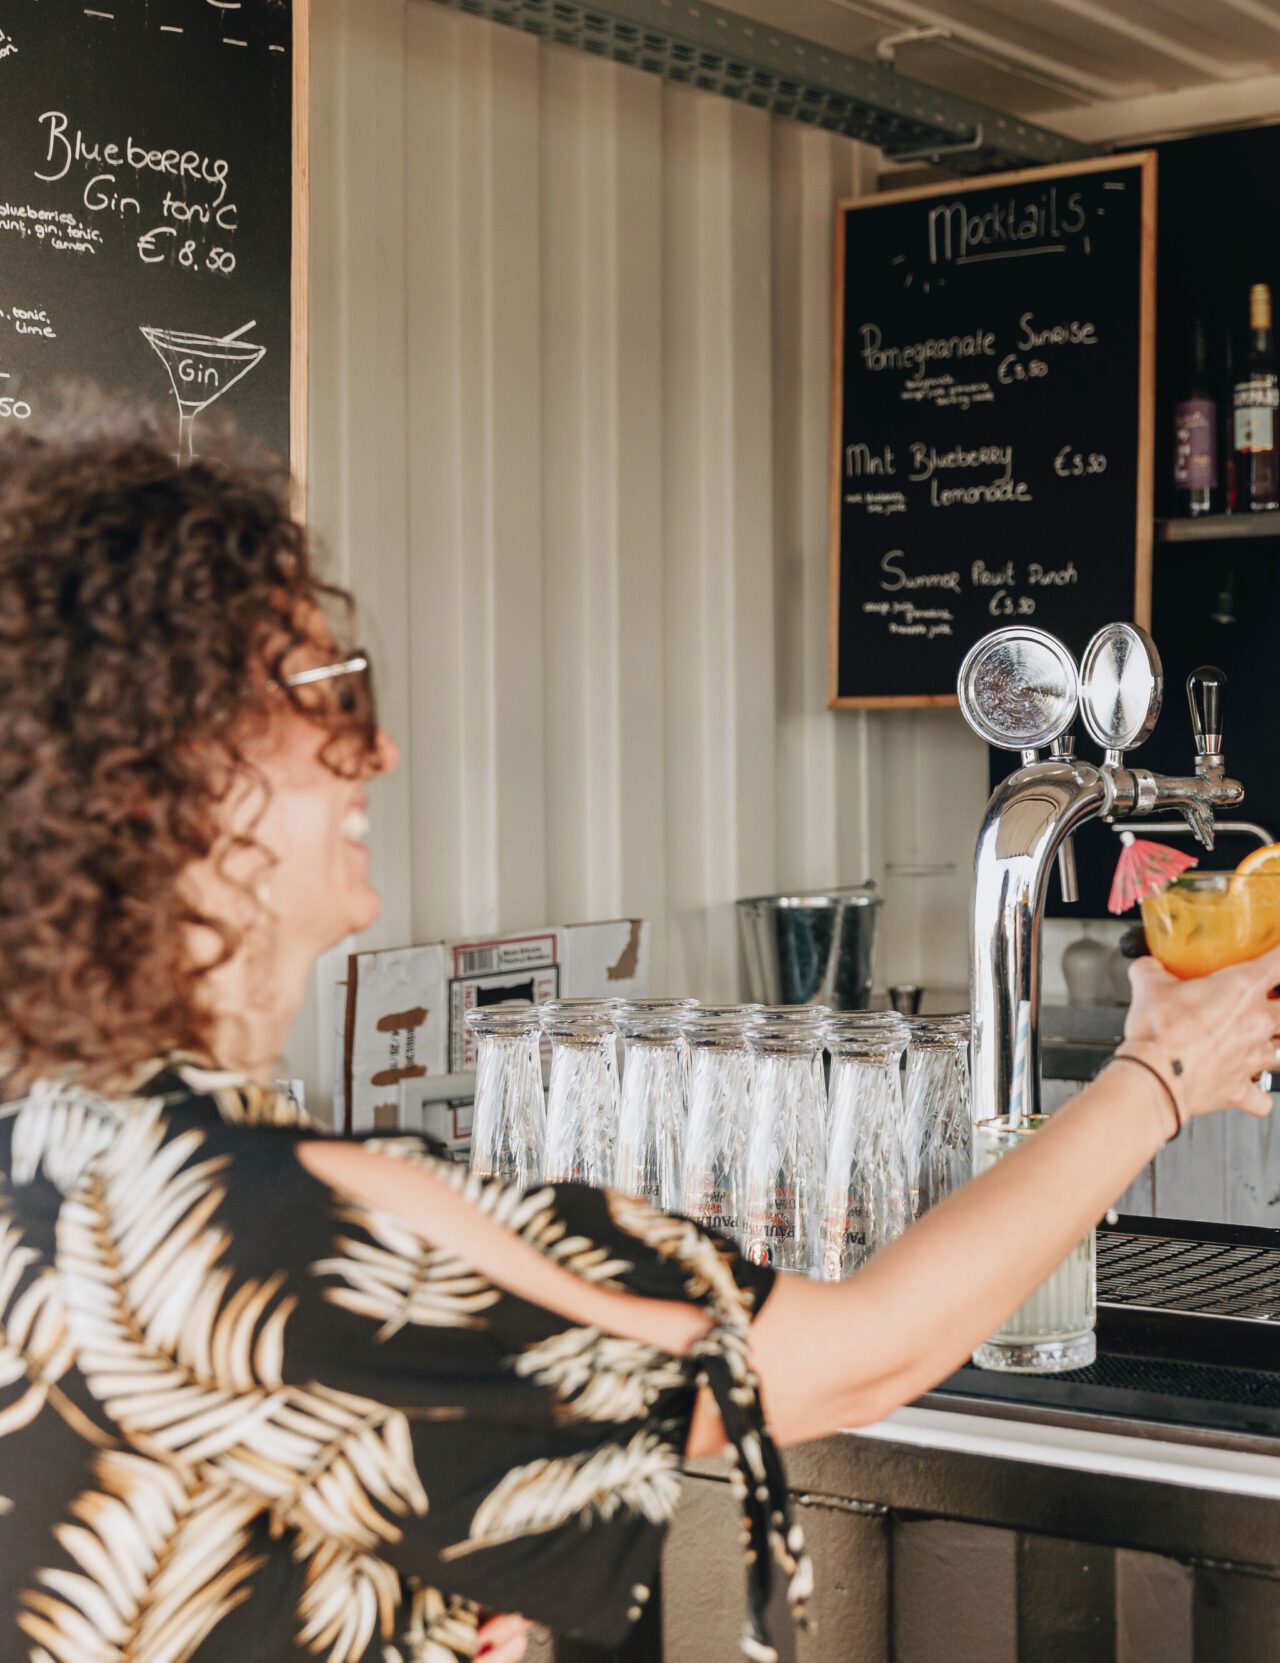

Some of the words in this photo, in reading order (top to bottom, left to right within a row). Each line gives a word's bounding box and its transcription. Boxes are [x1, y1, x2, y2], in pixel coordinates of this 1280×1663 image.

[84, 175, 140, 214] Gin
[929, 187, 1086, 264] Mocktails
[178, 359, 219, 387] Gin
